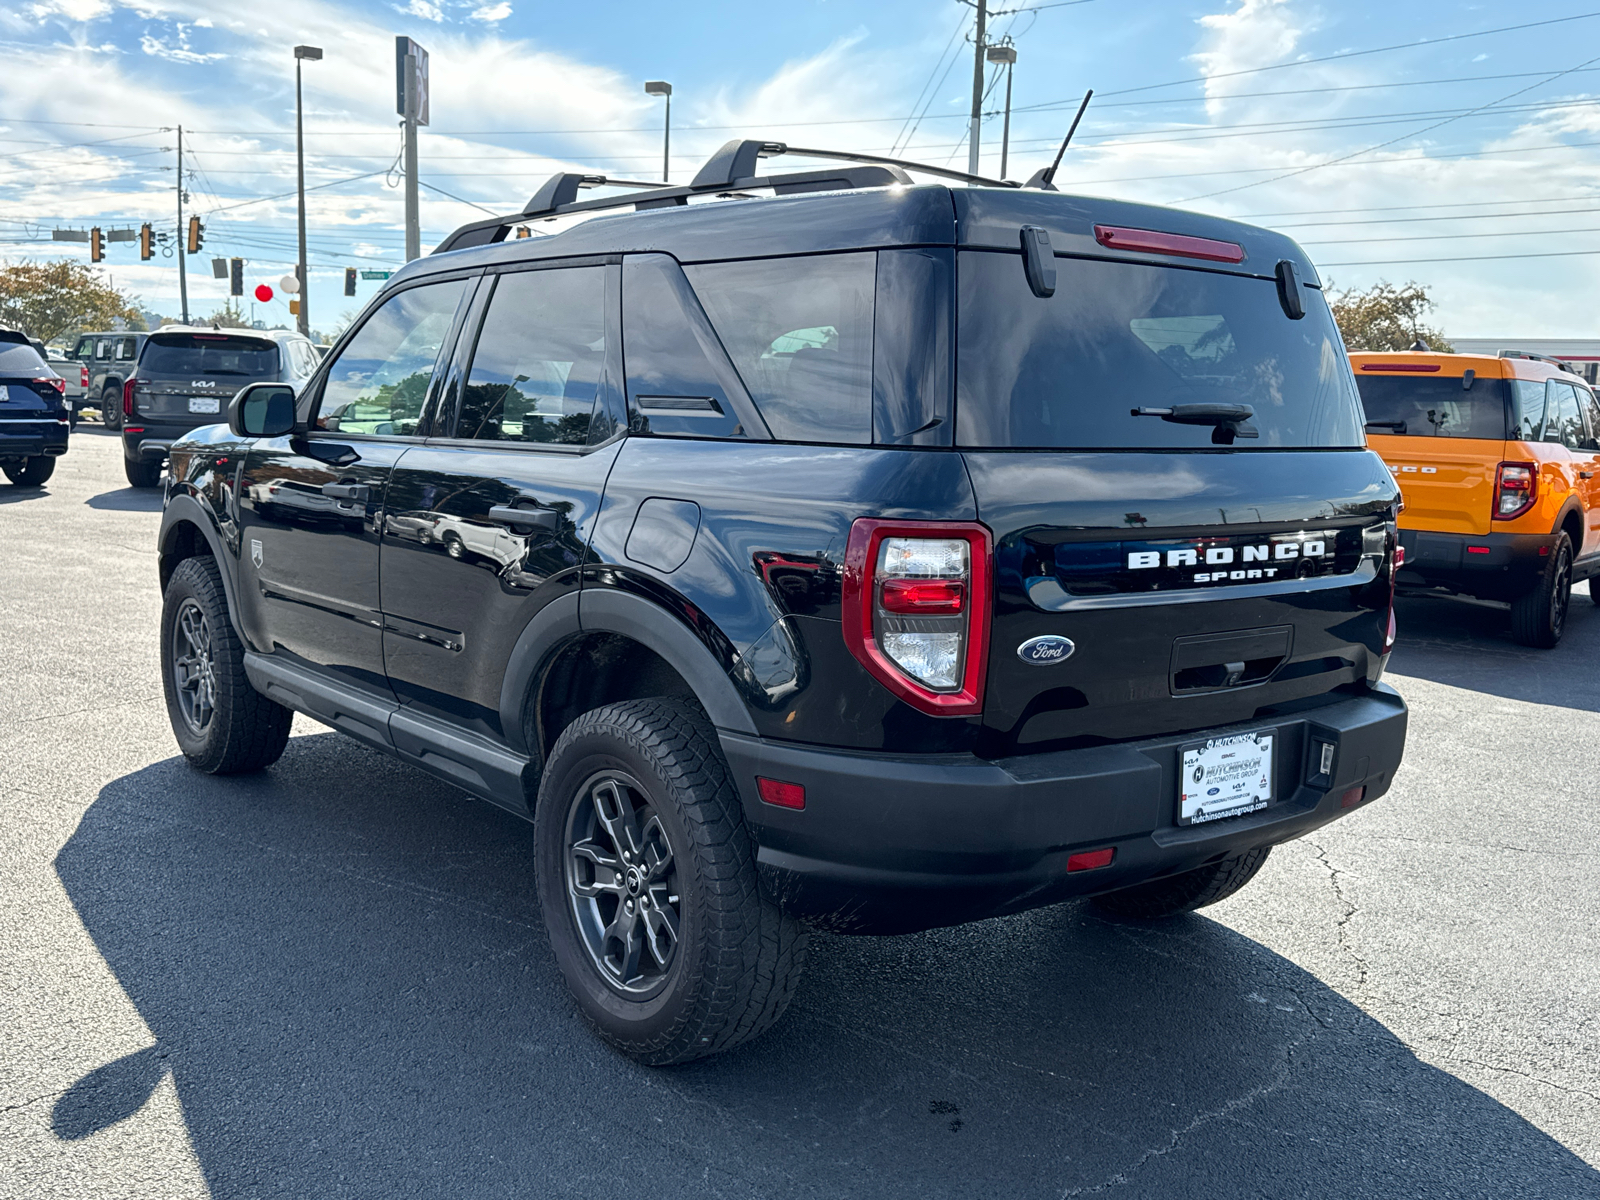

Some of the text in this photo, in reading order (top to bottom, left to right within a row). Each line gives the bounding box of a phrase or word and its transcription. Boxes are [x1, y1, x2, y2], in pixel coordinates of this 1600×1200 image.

[1128, 541, 1325, 569] BRONCO
[1193, 568, 1278, 582] SPORT
[1032, 642, 1064, 659] Ford
[1214, 732, 1258, 748] HUTCHINSON
[1206, 757, 1262, 778] HUTCHINSON
[1206, 769, 1259, 785] AUTOMOTIVE GROUP
[1232, 782, 1246, 790] KIA
[1191, 801, 1268, 825] Hutchinsonautogroup.com
